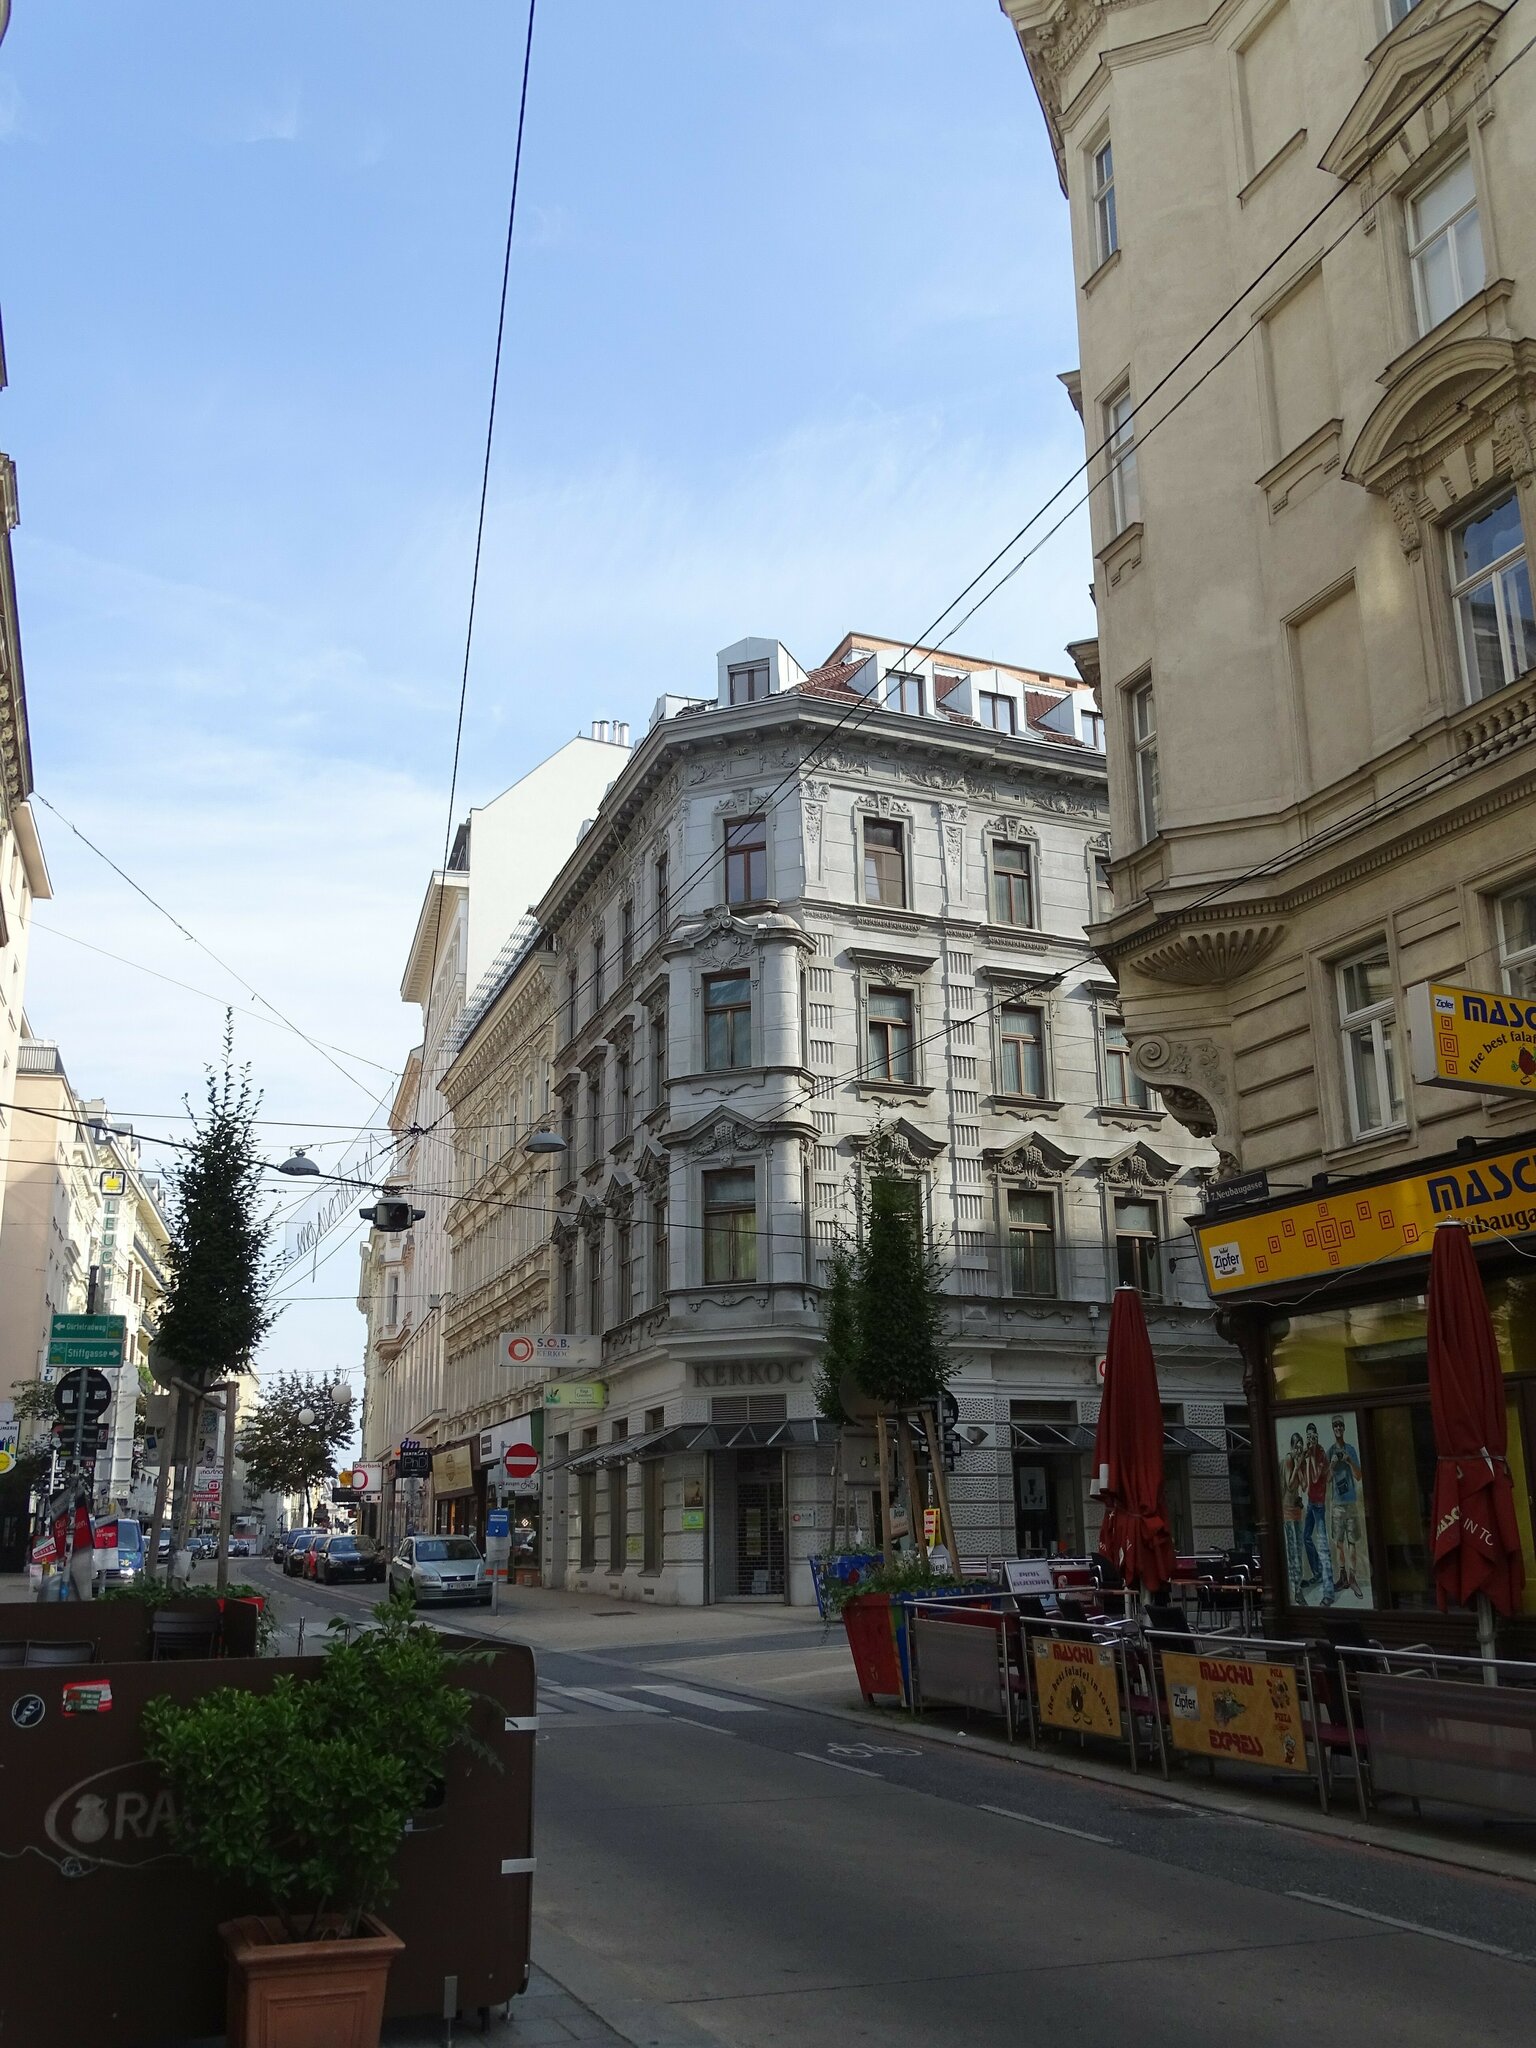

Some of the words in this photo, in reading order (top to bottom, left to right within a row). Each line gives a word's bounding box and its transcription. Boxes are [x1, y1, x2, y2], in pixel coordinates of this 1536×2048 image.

[1435, 998, 1454, 1010] Zipfer
[1468, 1052, 1485, 1074] the
[1482, 1033, 1508, 1054] best
[1427, 1155, 1536, 1214] MASC
[1213, 1252, 1239, 1270] Zipfer
[536, 1350, 570, 1358] KERKOC
[693, 1361, 804, 1388] KERKOC
[400, 1437, 421, 1449] dm
[354, 1462, 382, 1470] Oberbank
[404, 1456, 428, 1469] PhD
[1463, 1517, 1479, 1535] IN
[1052, 1643, 1094, 1665] MASCHU
[1199, 1661, 1254, 1687] MASCHU
[1064, 1665, 1090, 1682] falafel
[1090, 1677, 1098, 1692] in
[1098, 1691, 1114, 1727] town
[1173, 1693, 1196, 1711] Zipfer
[1275, 1712, 1292, 1724] PIZZA
[1208, 1728, 1264, 1757] EXPRESS
